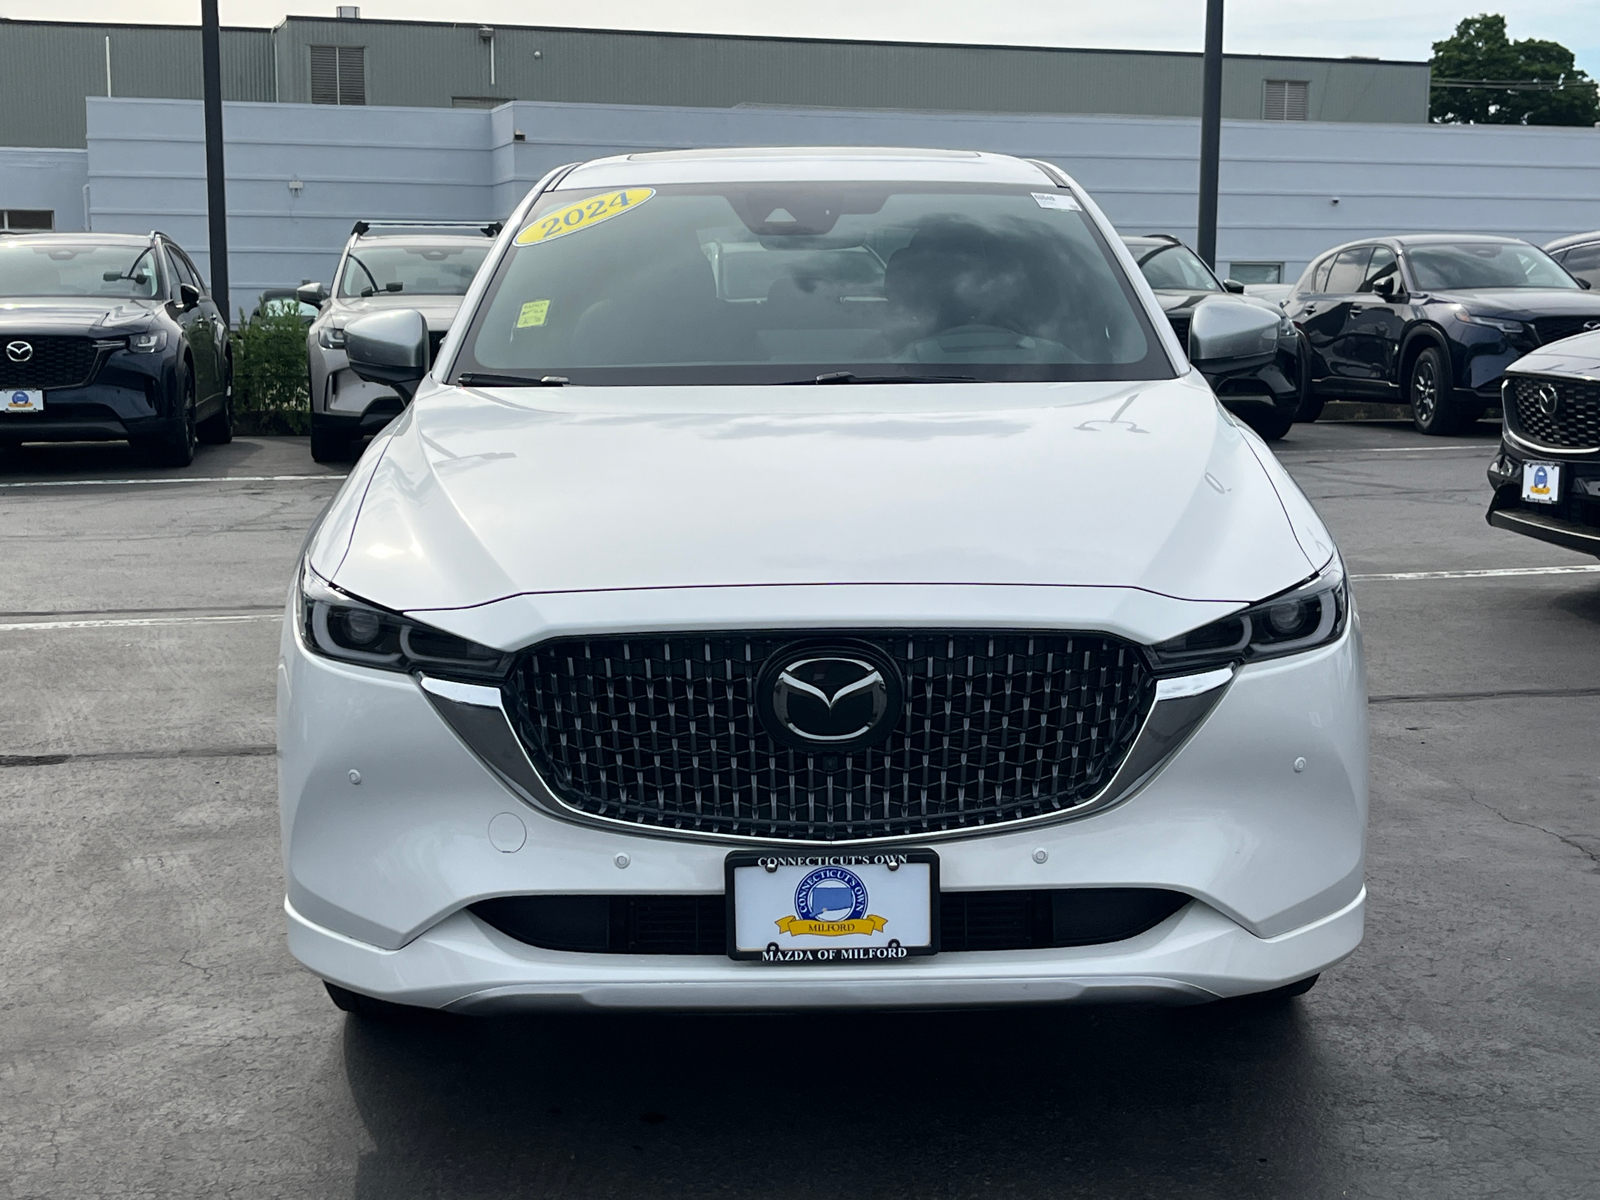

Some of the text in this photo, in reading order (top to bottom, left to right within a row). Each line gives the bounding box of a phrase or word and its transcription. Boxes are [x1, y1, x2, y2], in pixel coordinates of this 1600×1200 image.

[541, 191, 633, 238] 2024
[757, 854, 908, 867] CONNECTICUT'S OWN
[854, 886, 866, 912] OWN
[808, 923, 856, 932] MILFORD
[762, 947, 908, 961] MAZDA OF MILFORD
